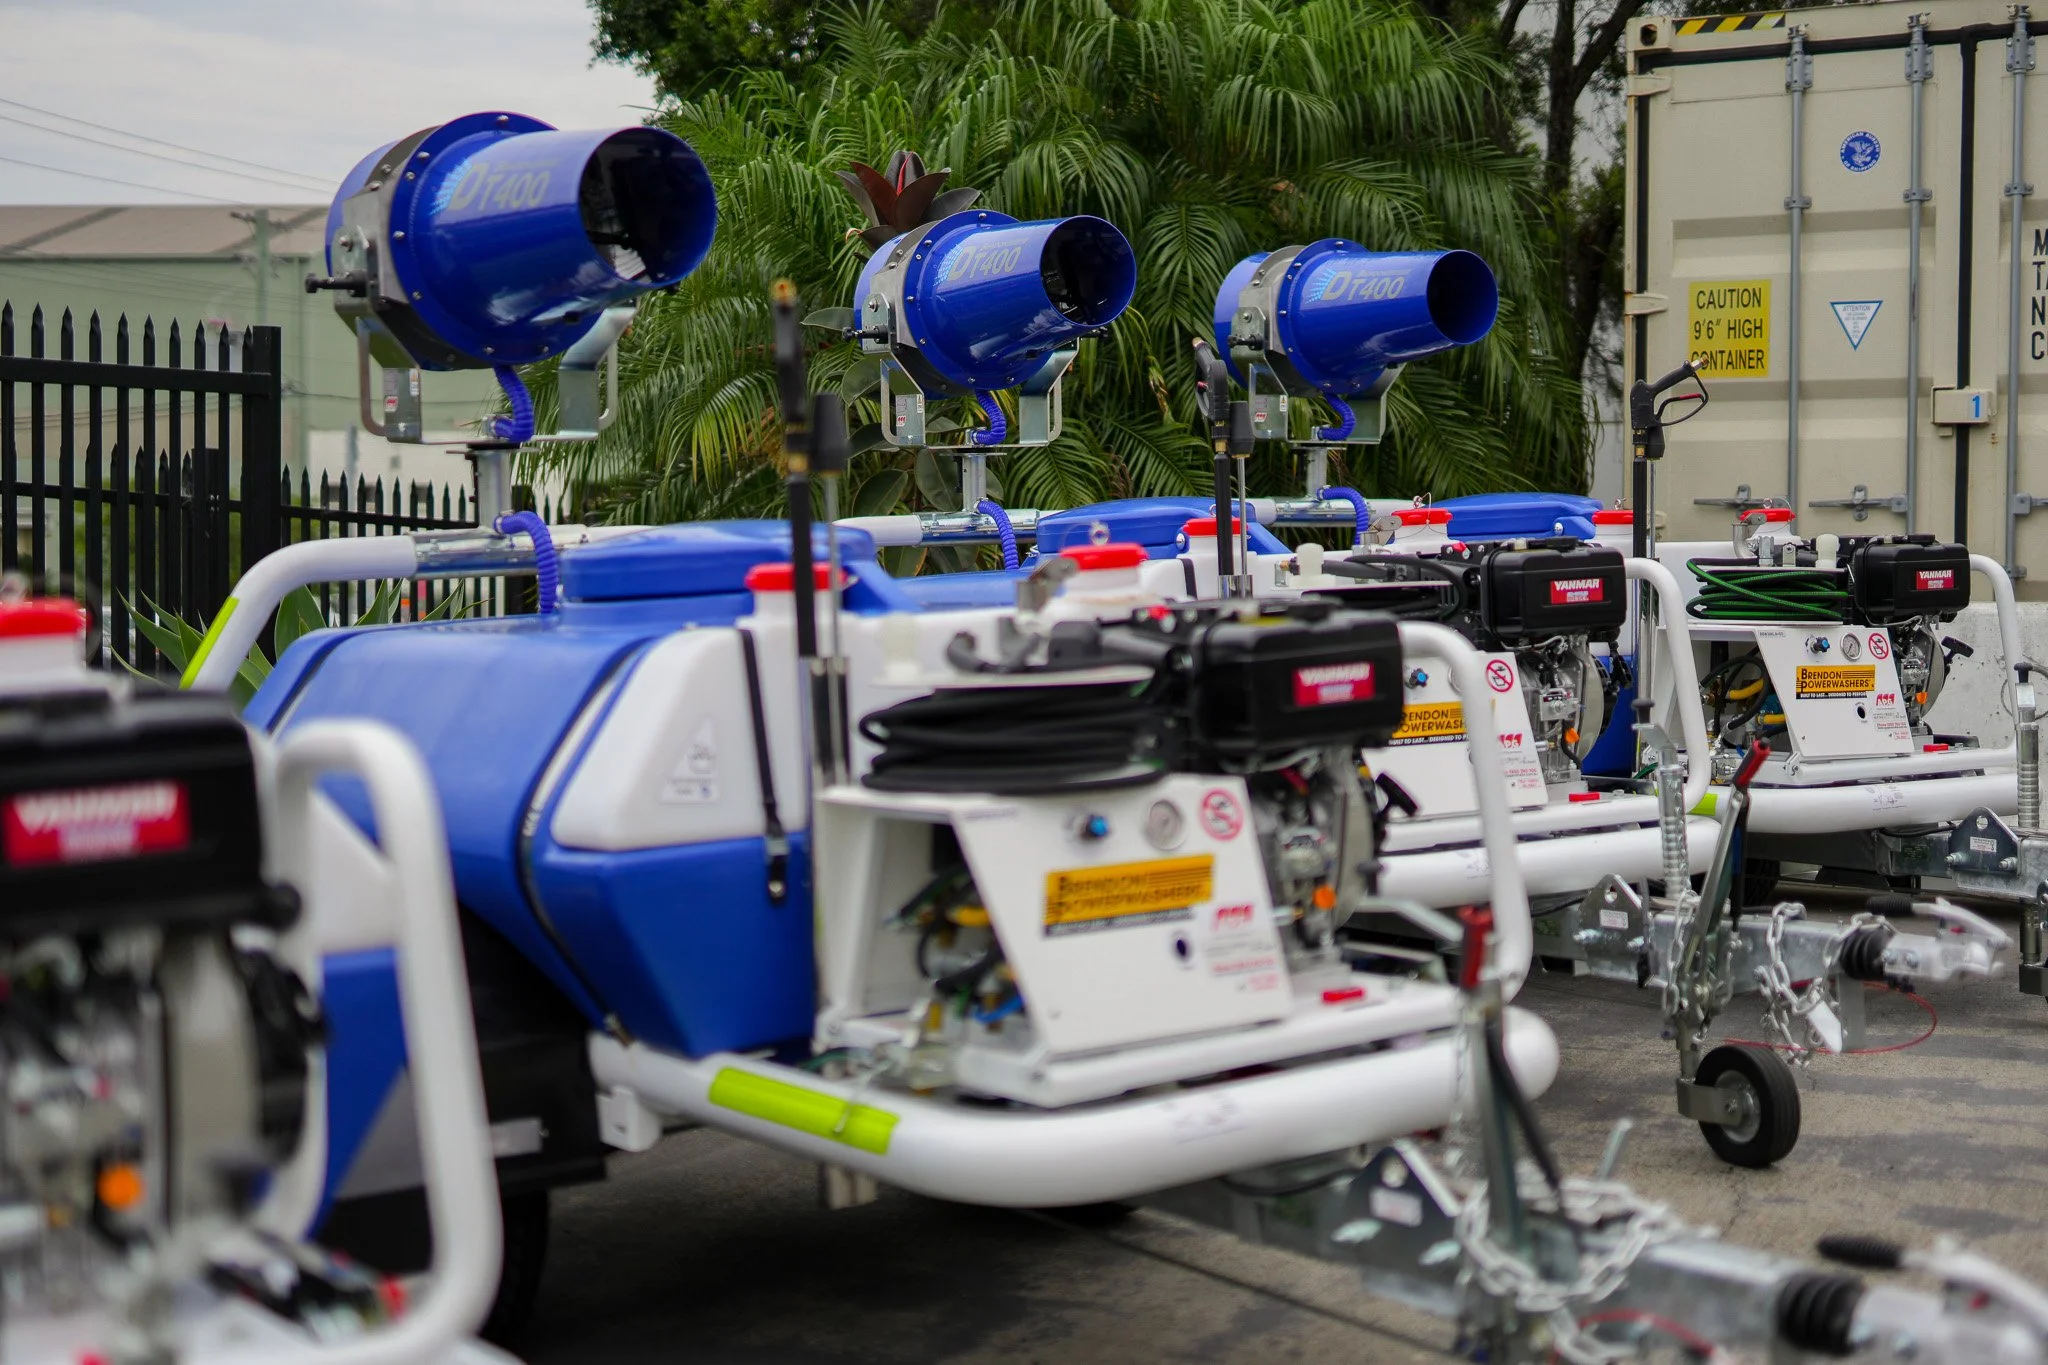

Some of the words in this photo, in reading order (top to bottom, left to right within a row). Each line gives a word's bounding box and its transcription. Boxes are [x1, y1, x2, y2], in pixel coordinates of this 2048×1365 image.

[446, 162, 551, 211] DT400
[948, 245, 1022, 280] DT400
[1321, 270, 1405, 301] DT400
[1696, 287, 1762, 309] CAUTION
[1727, 318, 1763, 339] HIGH
[1972, 395, 1981, 418] 1
[1554, 578, 1600, 591] YANMAR
[1919, 569, 1952, 579] YANMAR
[1801, 668, 1842, 680] BRENDON
[1800, 679, 1869, 693] POWERWASHERS
